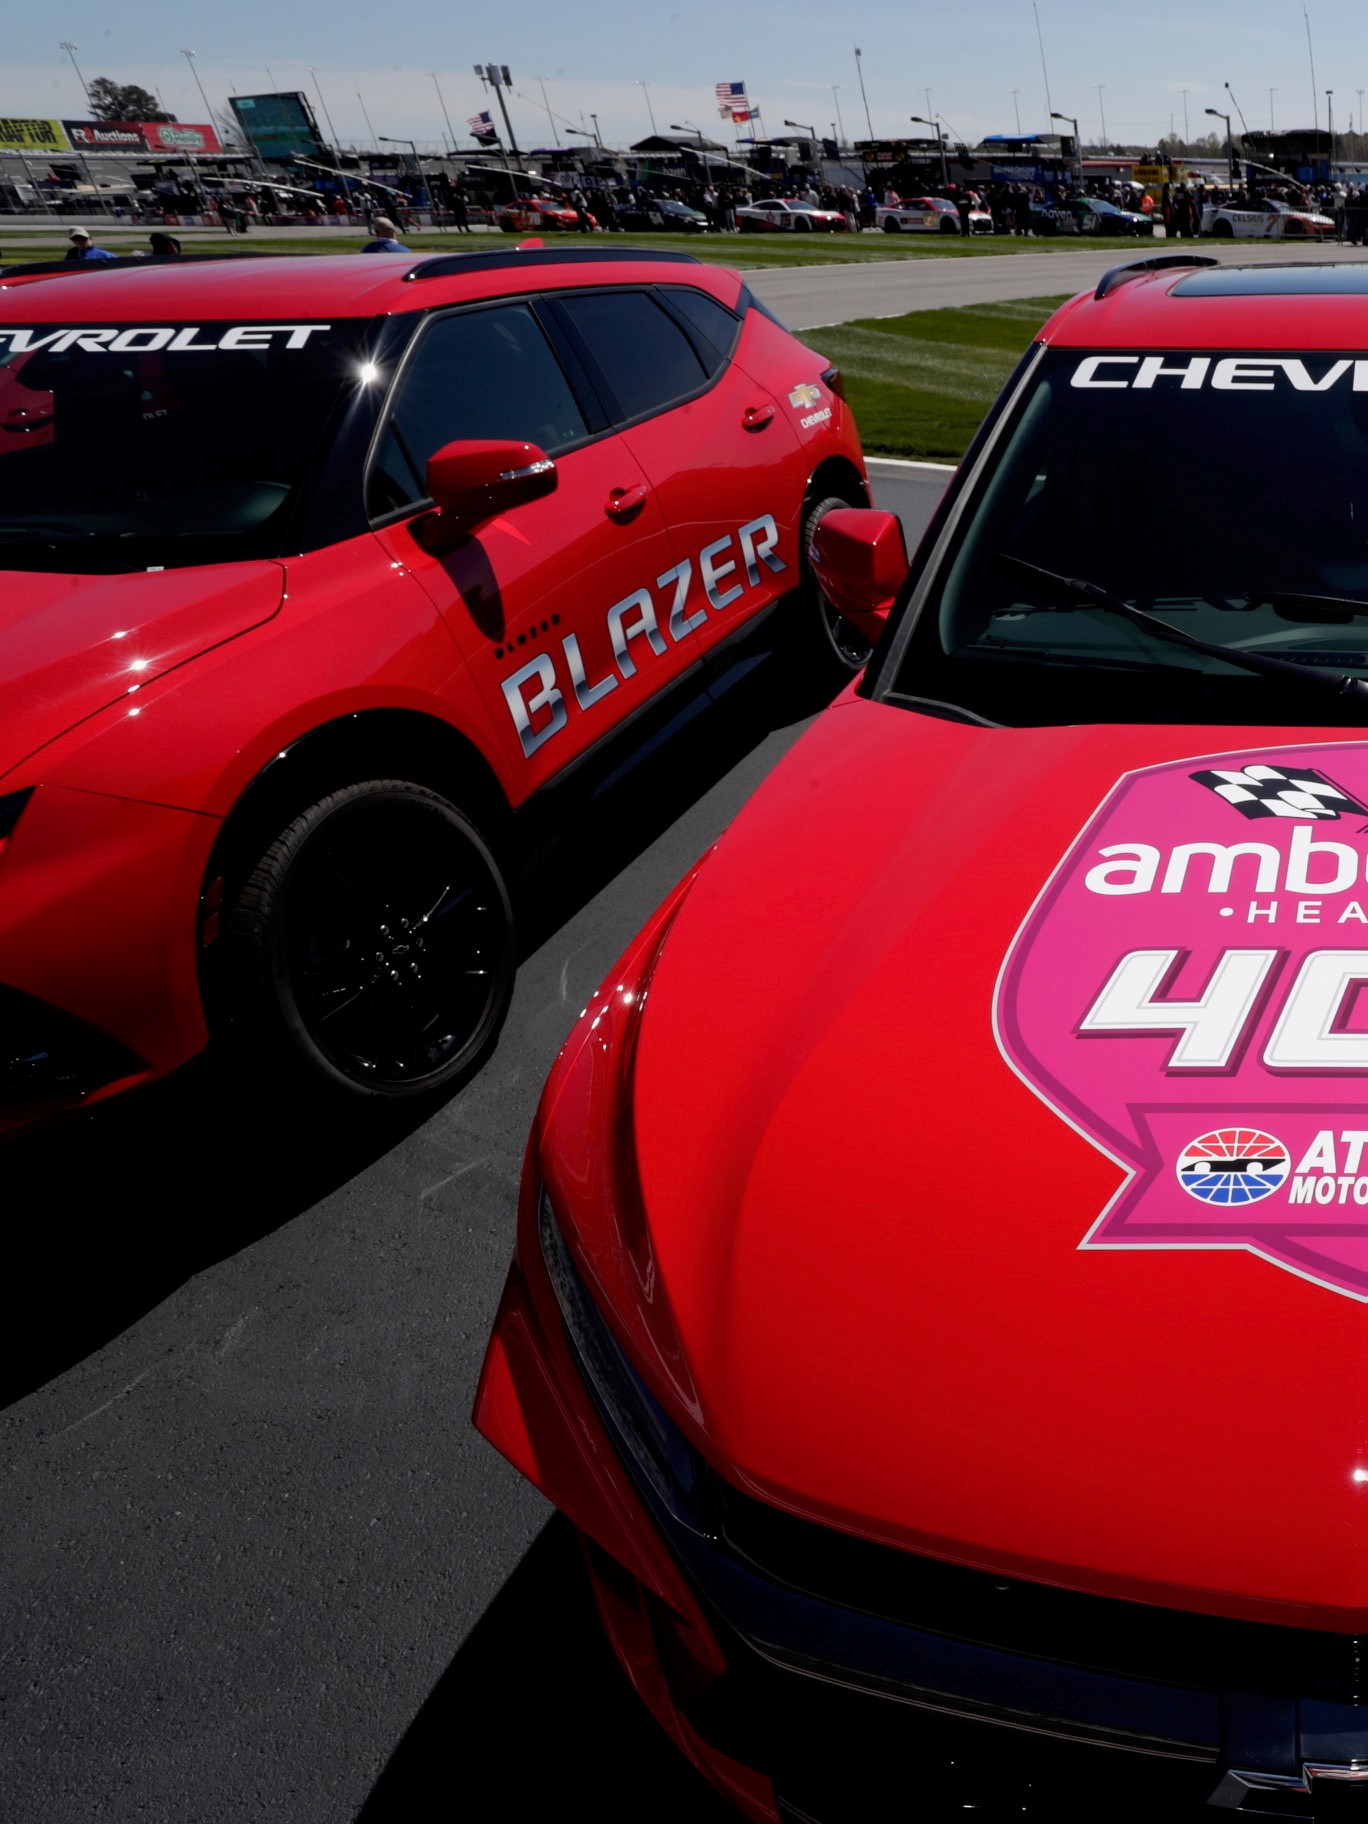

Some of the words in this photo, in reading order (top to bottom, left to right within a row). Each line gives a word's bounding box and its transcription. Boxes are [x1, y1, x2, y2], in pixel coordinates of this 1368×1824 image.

[1233, 214, 1264, 223] CELSIUS
[0, 325, 331, 353] VROLET
[501, 513, 787, 759] BLAZER
